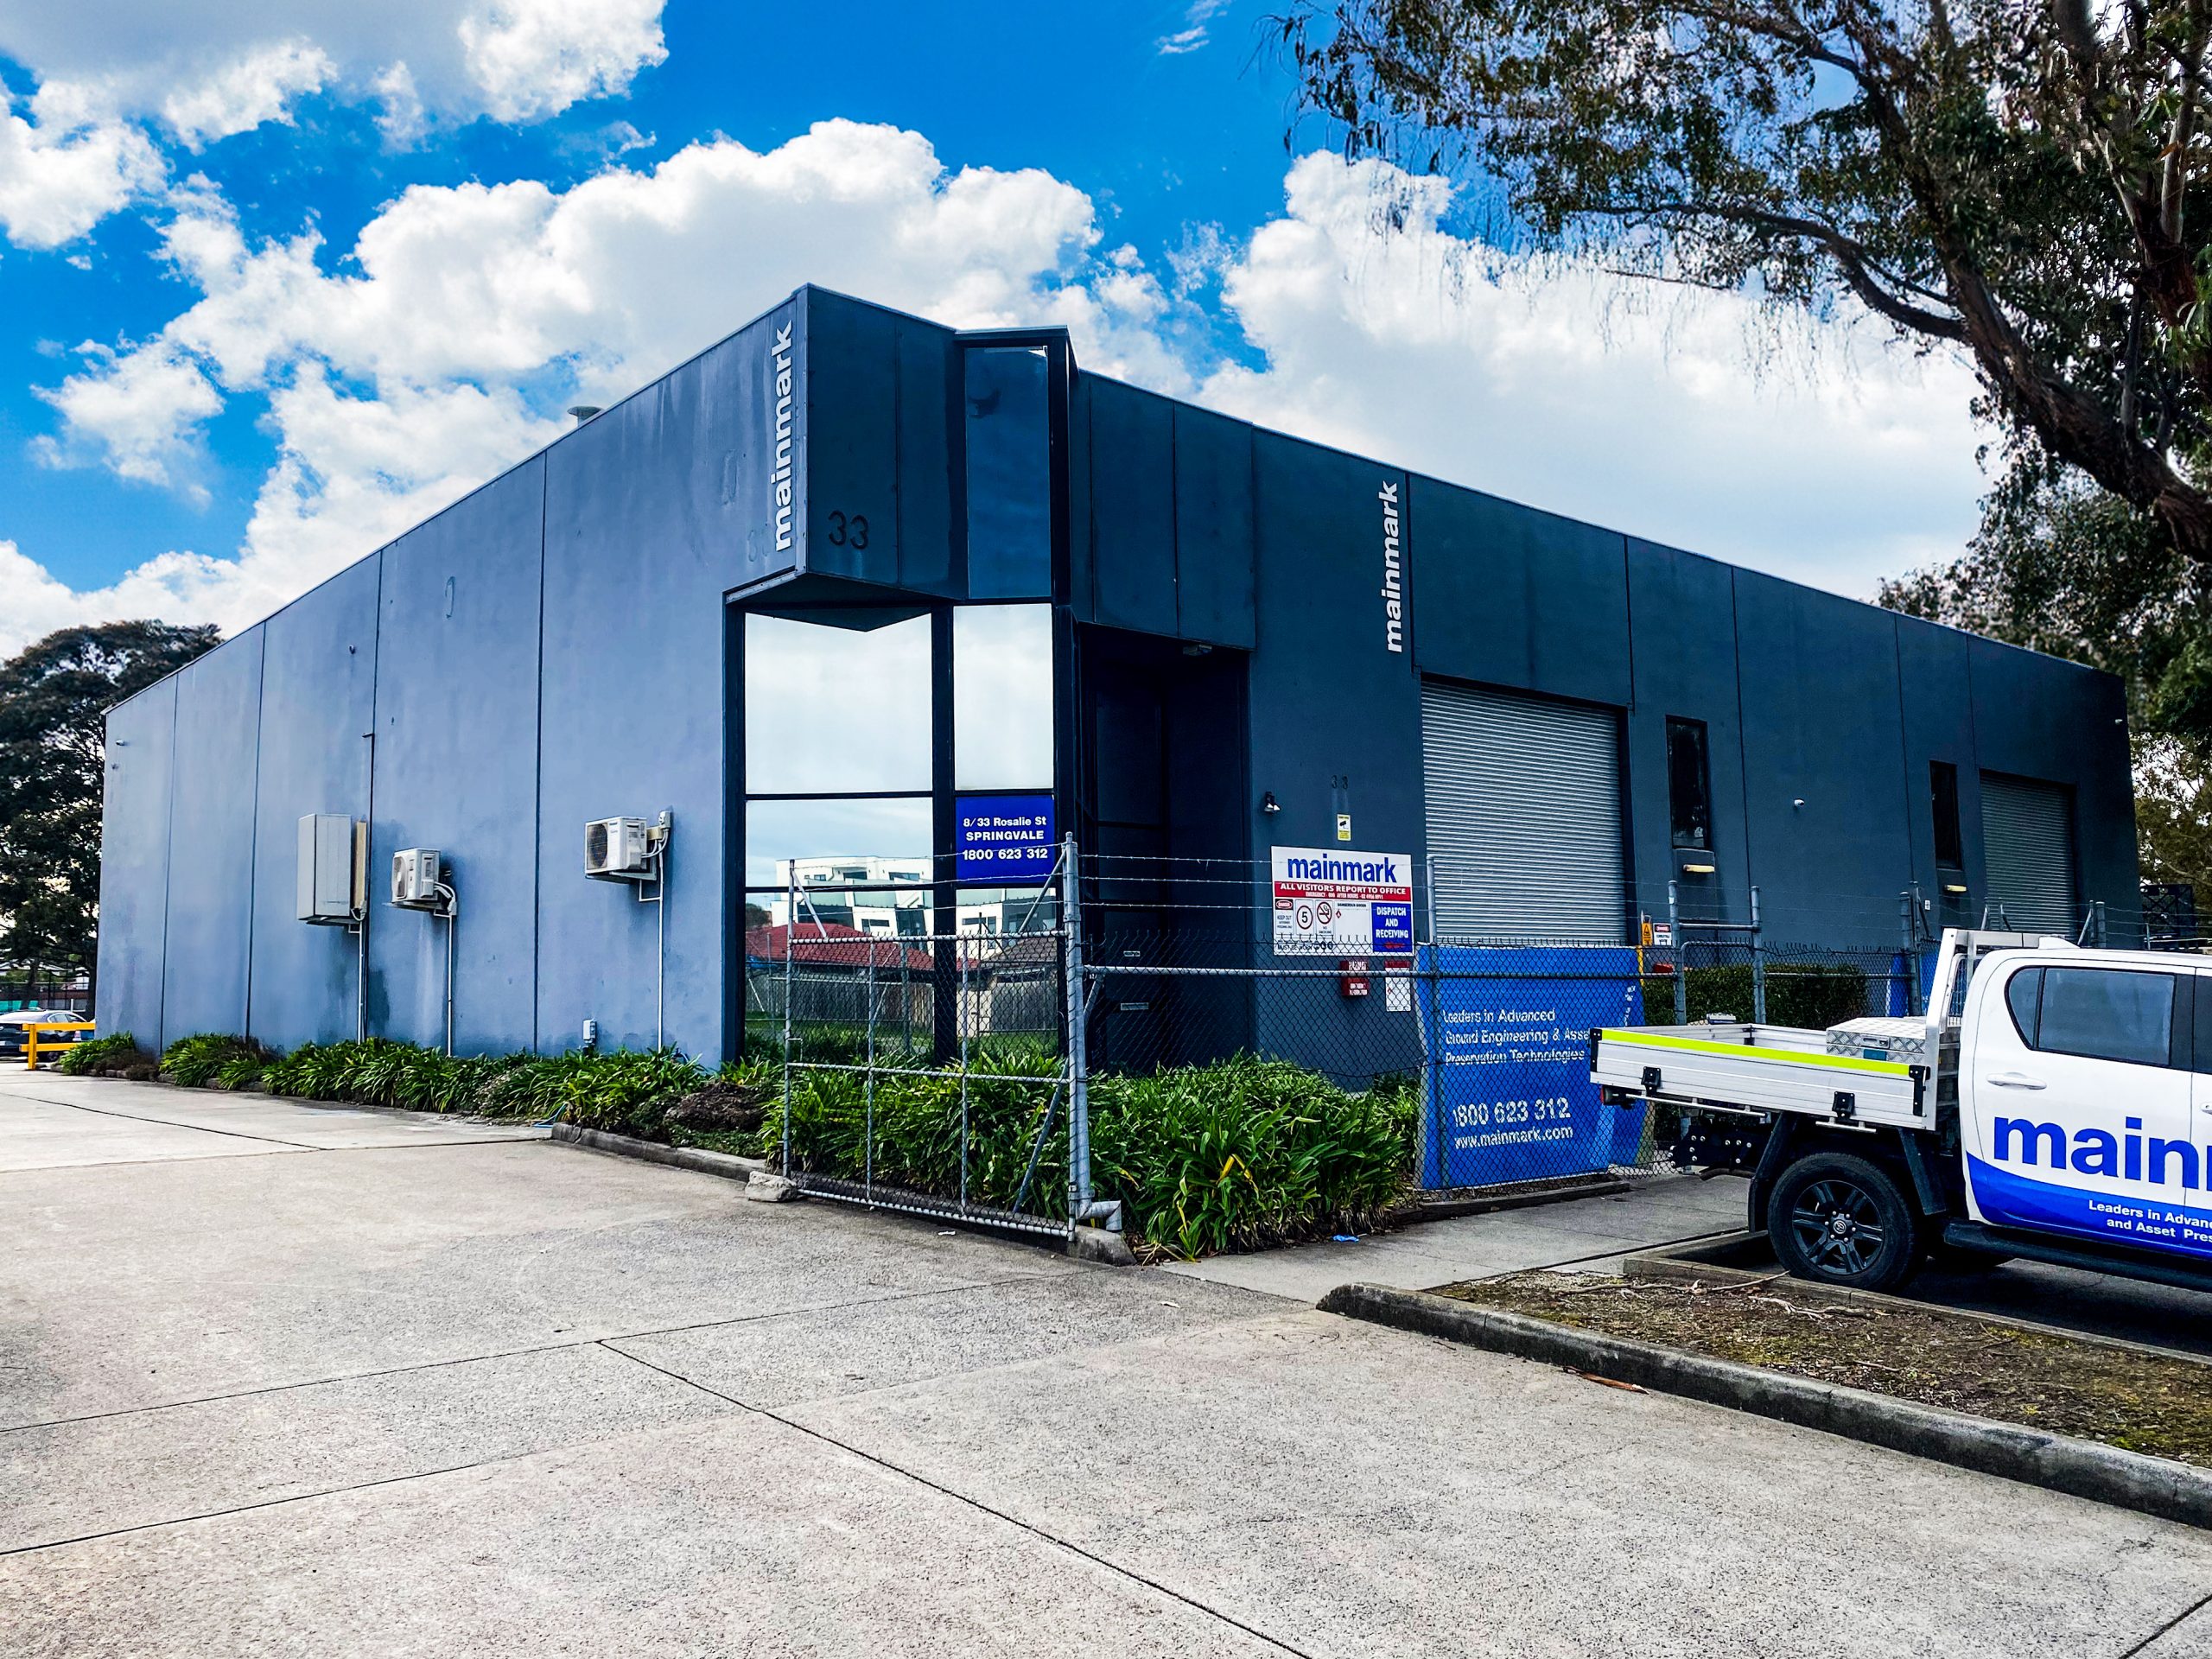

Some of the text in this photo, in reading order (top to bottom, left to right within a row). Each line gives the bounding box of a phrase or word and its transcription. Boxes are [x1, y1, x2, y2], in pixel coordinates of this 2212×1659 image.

[771, 320, 792, 551] mainmark
[828, 510, 869, 550] 33
[1378, 480, 1402, 652] mainmark
[963, 816, 1046, 827] 8/33 Rosalie St
[966, 830, 1044, 841] SPRINGVALE
[963, 848, 1048, 860] 1800 623 312
[1287, 854, 1396, 883] mainmark
[1301, 912, 1307, 923] 5
[1376, 906, 1407, 916] DISPATCH
[1385, 918, 1398, 926] AND
[1376, 929, 1408, 938] RECEIVING
[1442, 1007, 1555, 1023] Leaders in Advanced
[1481, 1029, 1548, 1046] Engineering
[1552, 1028, 1560, 1041] &
[1510, 1047, 1585, 1064] Technologies
[1453, 1097, 1571, 1127] 1800 623 312
[1454, 1126, 1573, 1149] www.mainmark.com
[1994, 1116, 2212, 1192] main
[2088, 1199, 2144, 1217] Leaders
[2147, 1208, 2160, 1220] in
[2107, 1218, 2132, 1230] and
[2135, 1221, 2176, 1237] Asset
